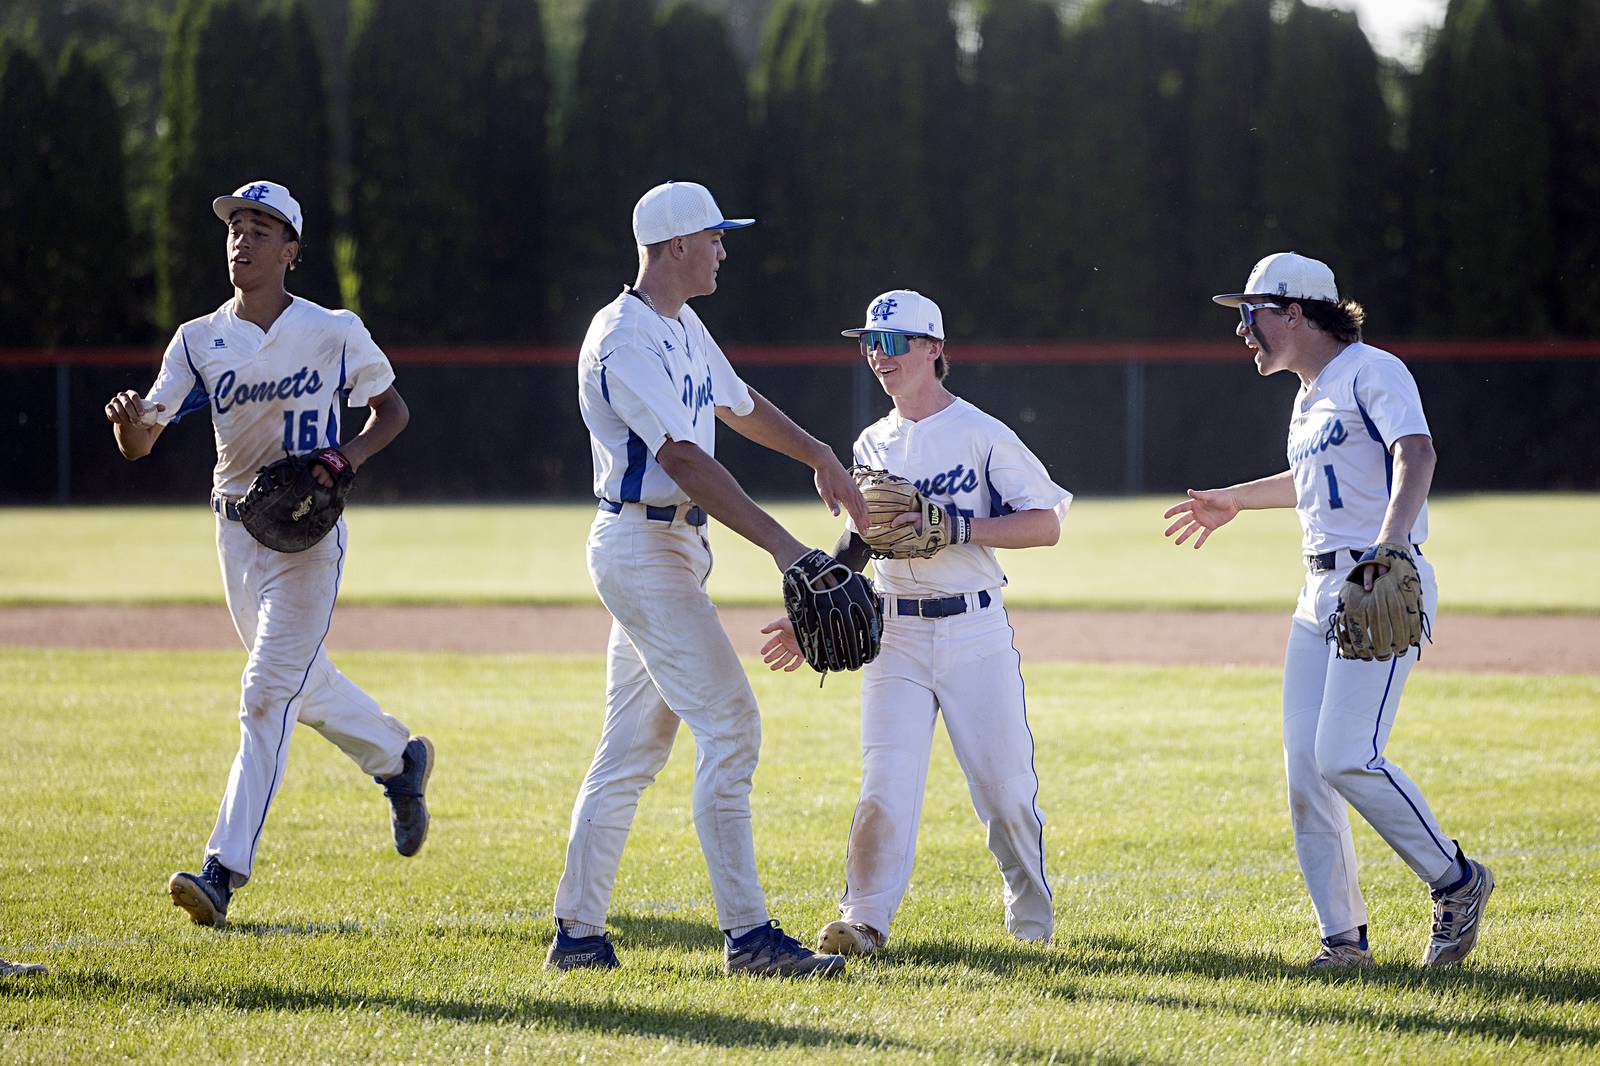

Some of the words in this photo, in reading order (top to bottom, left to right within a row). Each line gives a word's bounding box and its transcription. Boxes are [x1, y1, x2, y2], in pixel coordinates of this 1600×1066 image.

[214, 366, 323, 415] Comets
[282, 409, 318, 451] 16
[1289, 417, 1348, 464] omets
[913, 464, 978, 498] mets
[1324, 464, 1344, 510] 1
